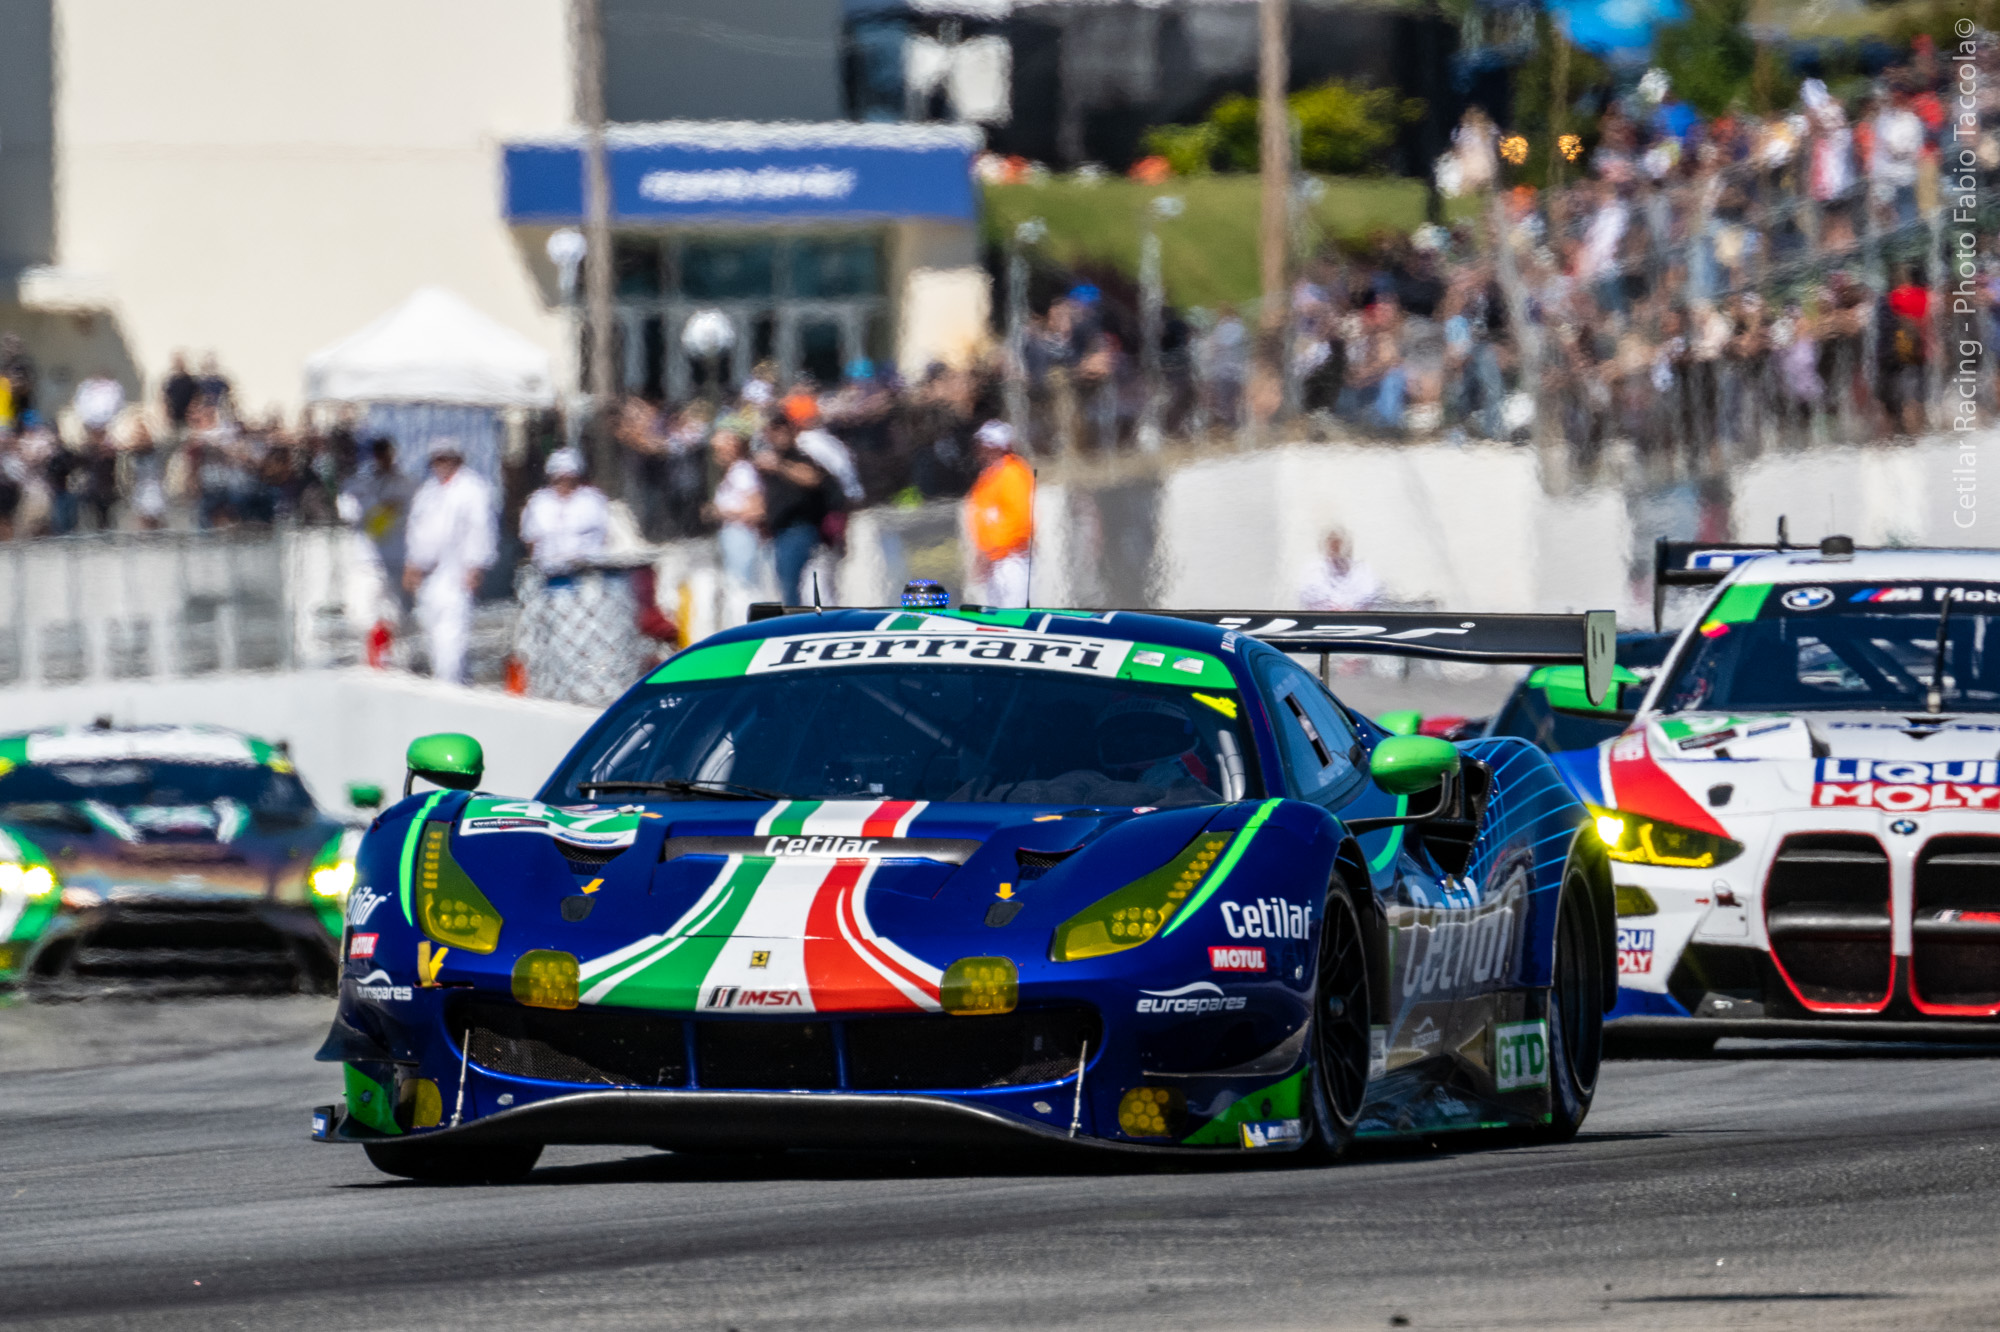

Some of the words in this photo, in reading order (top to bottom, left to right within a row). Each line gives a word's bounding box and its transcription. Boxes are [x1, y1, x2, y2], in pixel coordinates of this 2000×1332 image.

[1934, 587, 2000, 602] Mot
[768, 634, 1105, 670] Ferrari
[1823, 759, 1998, 785] LIQUI
[1819, 782, 2000, 812] MOLY
[764, 836, 879, 857] Cetilar
[1220, 898, 1312, 940] Cetilar
[1618, 930, 1651, 950] QUI
[1213, 949, 1265, 968] MOTUL
[1618, 954, 1651, 974] OLY
[737, 990, 803, 1006] IMSA
[1136, 996, 1247, 1015] eurospares
[1499, 1033, 1545, 1080] GTD
